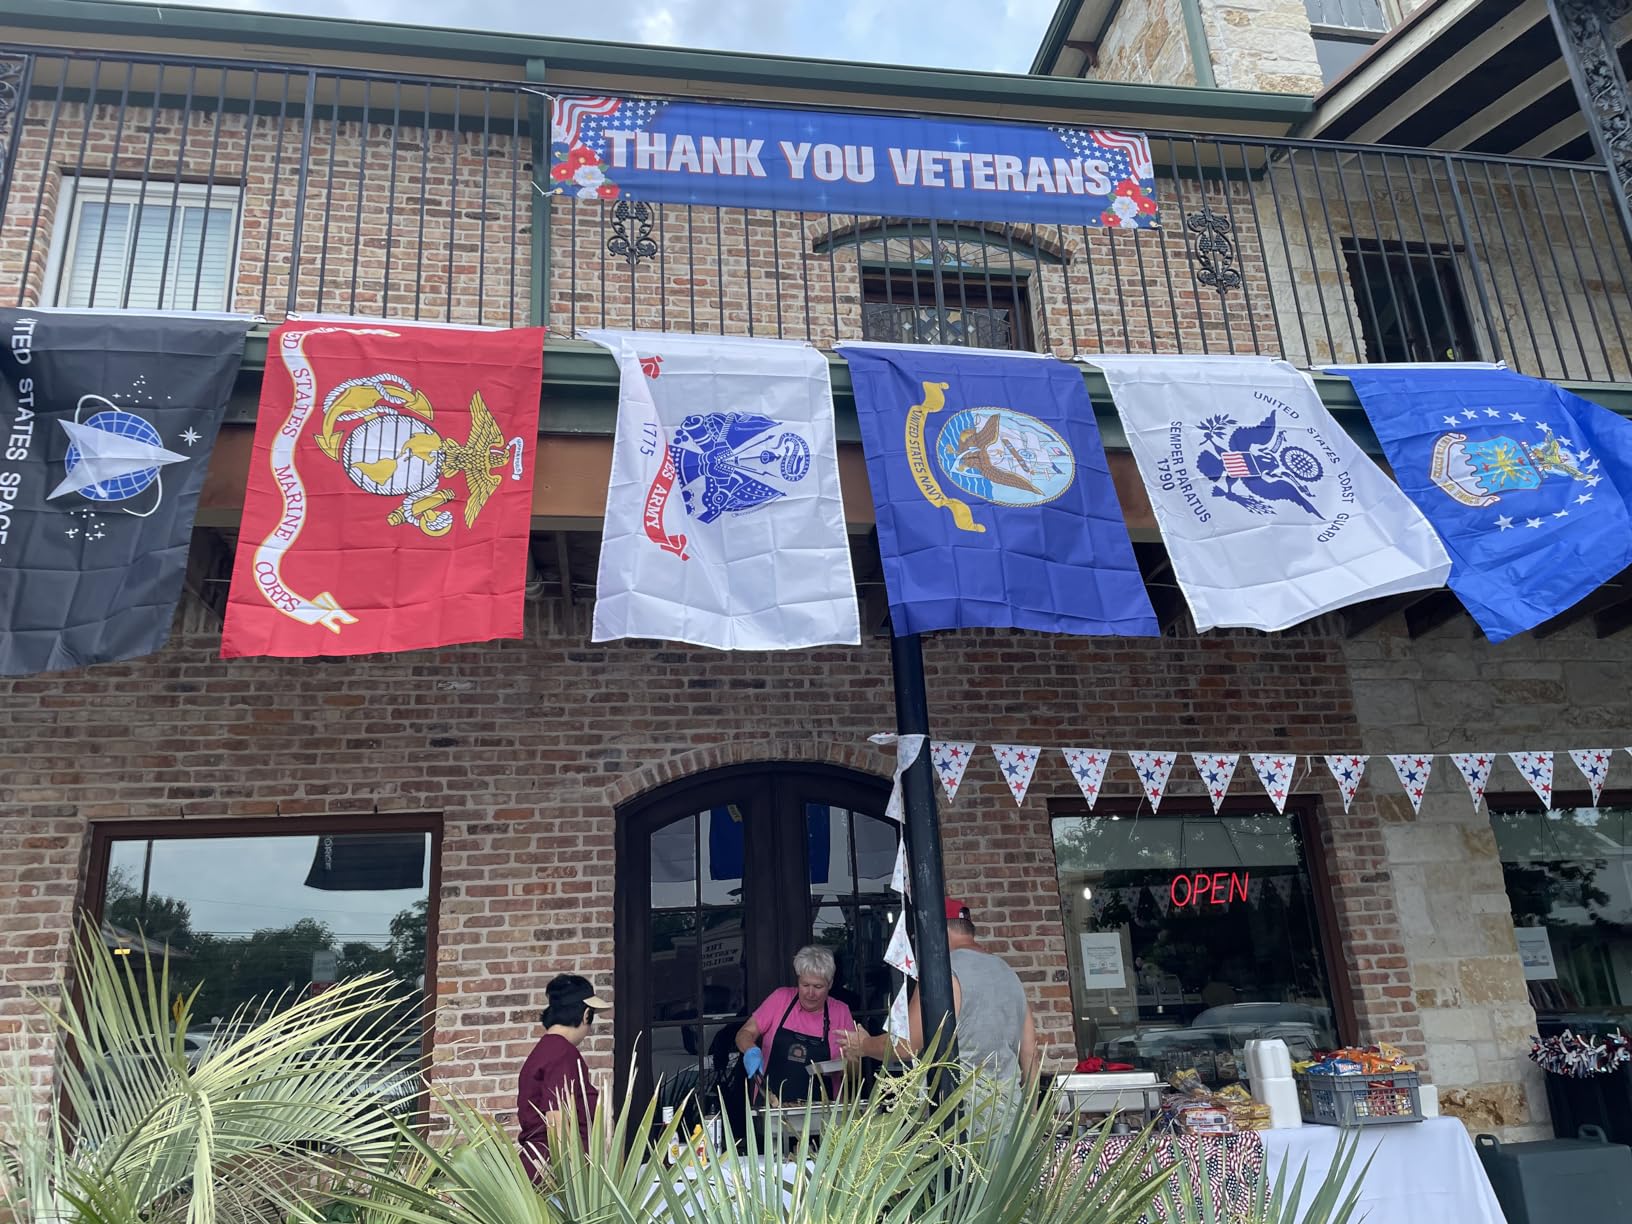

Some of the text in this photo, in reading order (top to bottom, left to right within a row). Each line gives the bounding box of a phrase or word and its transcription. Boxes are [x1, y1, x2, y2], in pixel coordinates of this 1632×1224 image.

[604, 129, 1112, 197] THANK YOU VETERANS
[6, 378, 34, 461] STATES
[282, 367, 312, 438] STATES
[1253, 391, 1300, 420] UNITED
[639, 422, 658, 457] 1775
[909, 410, 944, 502] UNITED STATES NAVY
[1306, 427, 1341, 465] STATES
[1157, 458, 1176, 492] 1790
[1170, 420, 1212, 523] SEMPER PARATUS
[1338, 471, 1354, 504] COAST
[274, 464, 304, 541] MARINE
[646, 484, 668, 531] ARMY
[1316, 512, 1350, 543] GUARD
[255, 561, 300, 613] CORPS
[1170, 872, 1249, 907] OPEN
